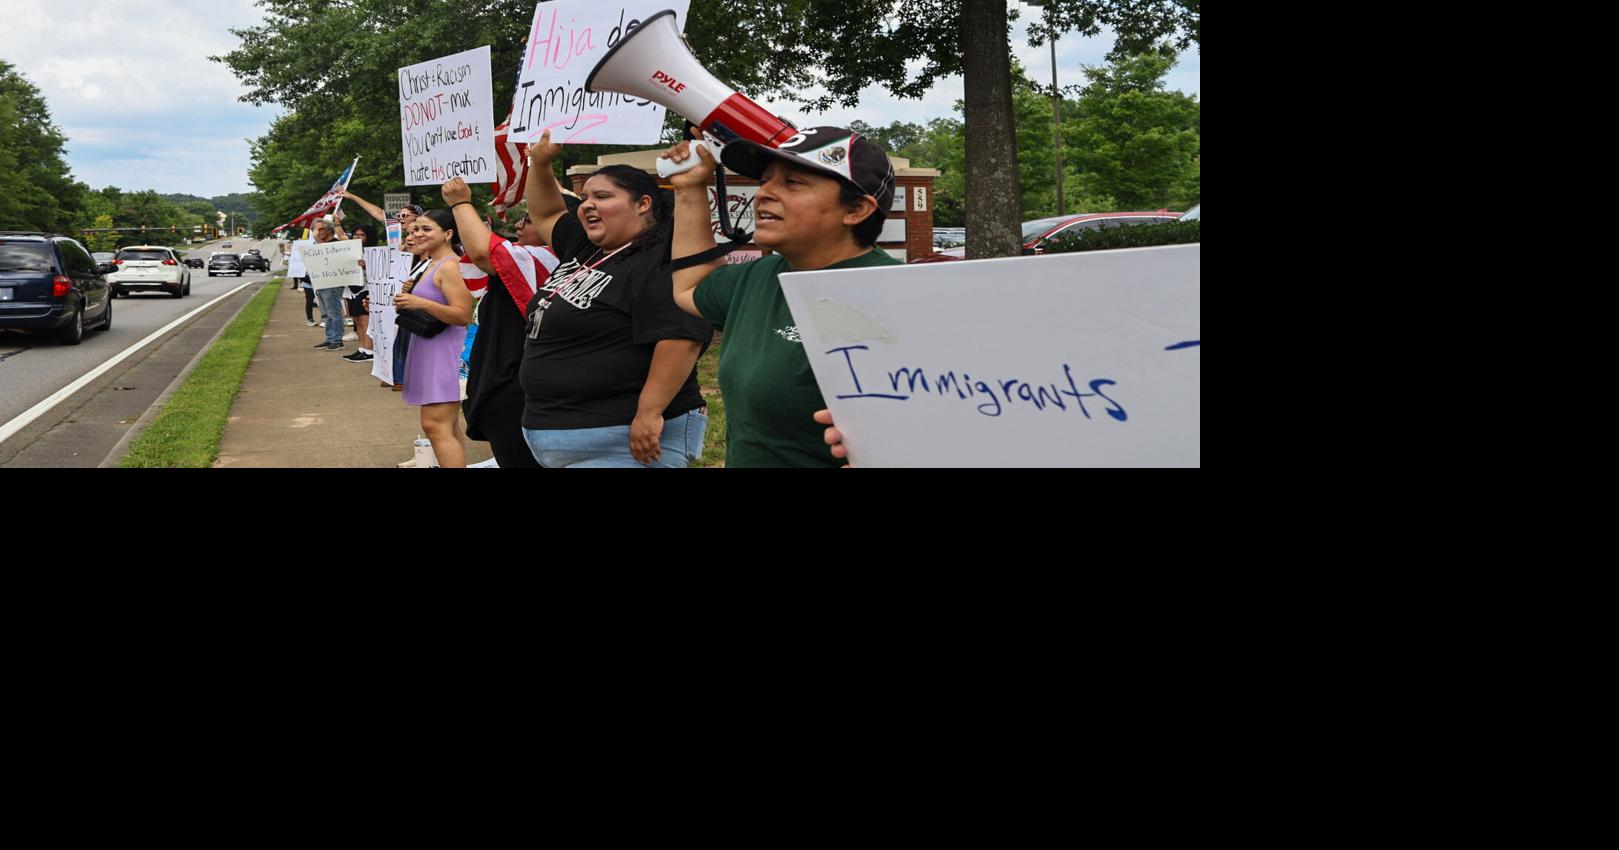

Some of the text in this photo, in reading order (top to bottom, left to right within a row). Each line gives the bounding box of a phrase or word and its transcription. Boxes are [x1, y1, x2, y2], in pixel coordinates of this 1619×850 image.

[528, 7, 642, 71] Hija de
[401, 69, 430, 100] Christ
[436, 63, 472, 88] Racism
[652, 70, 686, 94] PYLE
[404, 132, 424, 163] You
[458, 121, 472, 140] God
[431, 157, 446, 182] His
[916, 188, 924, 210] 559
[825, 344, 1130, 423] Immigrants
